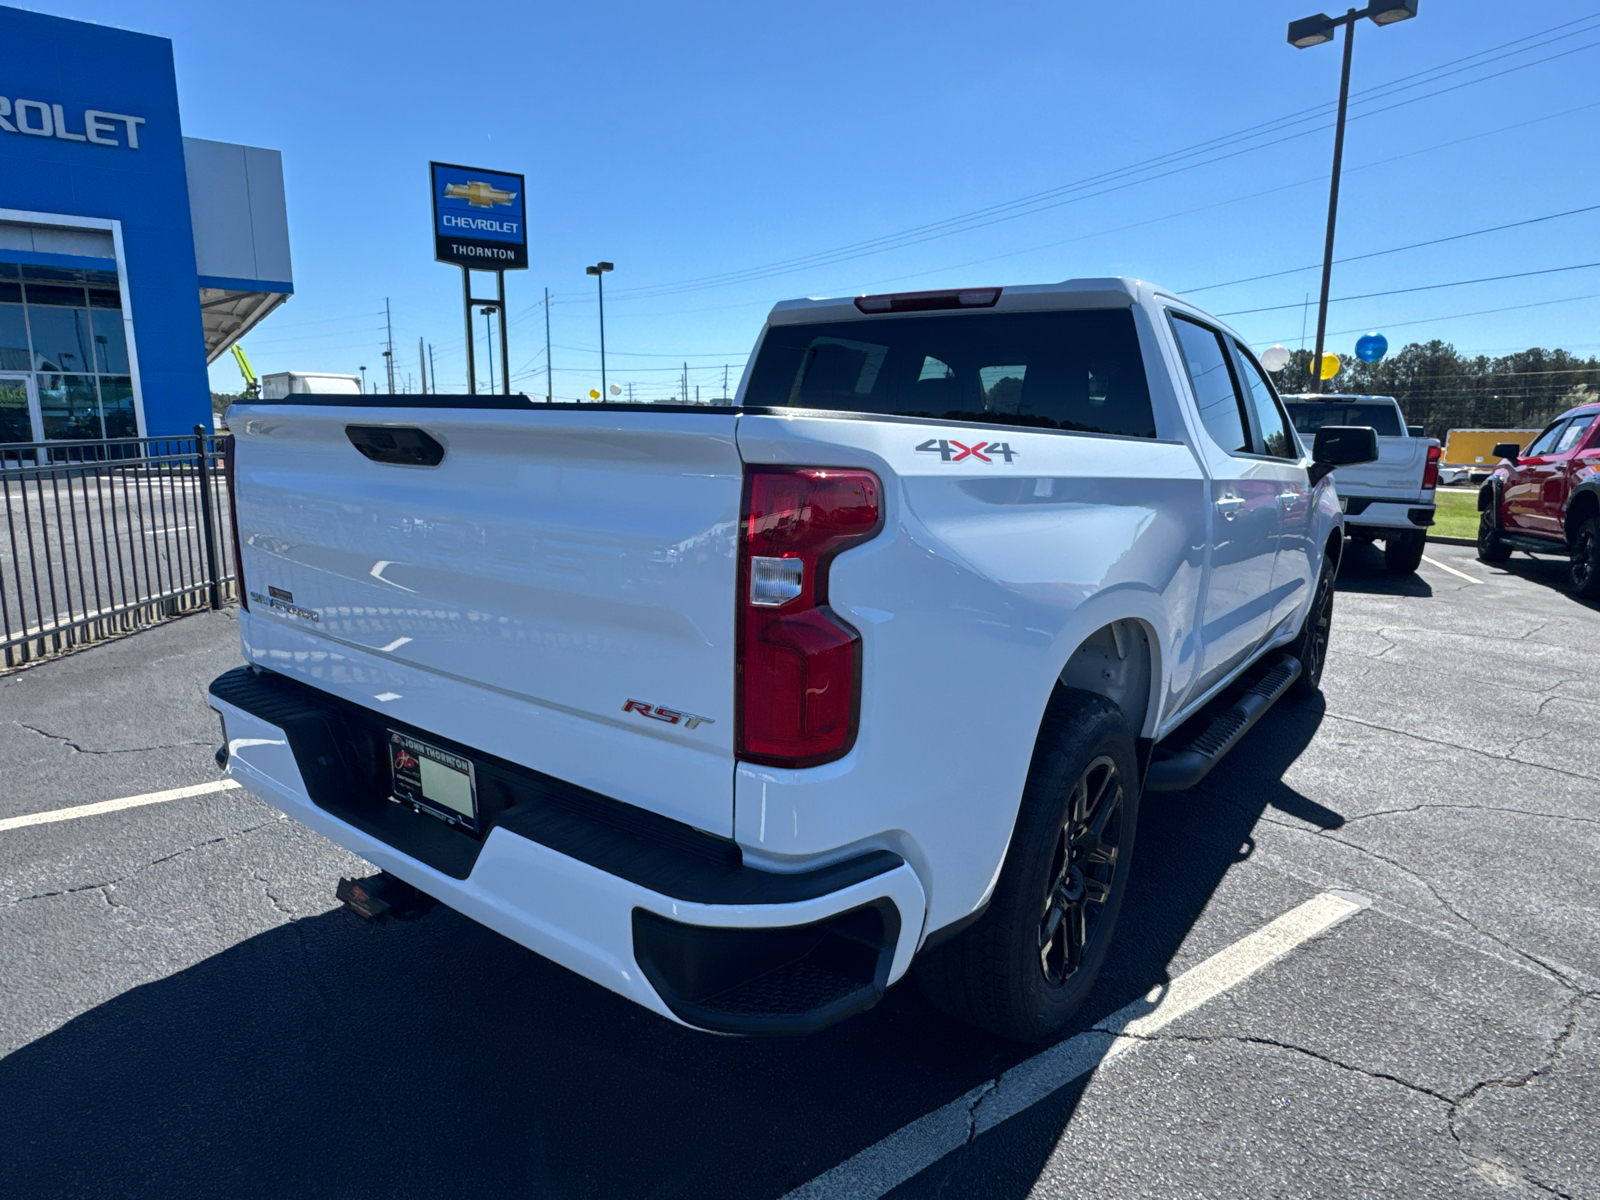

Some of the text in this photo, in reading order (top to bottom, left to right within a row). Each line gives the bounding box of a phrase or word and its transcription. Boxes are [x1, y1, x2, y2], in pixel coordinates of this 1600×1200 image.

[443, 215, 518, 233] CHEVROLET
[451, 244, 515, 260] THORNTON
[914, 438, 1019, 463] 4X4
[621, 698, 715, 729] RST
[404, 739, 425, 754] JOHN
[425, 747, 468, 771] THORNTON
